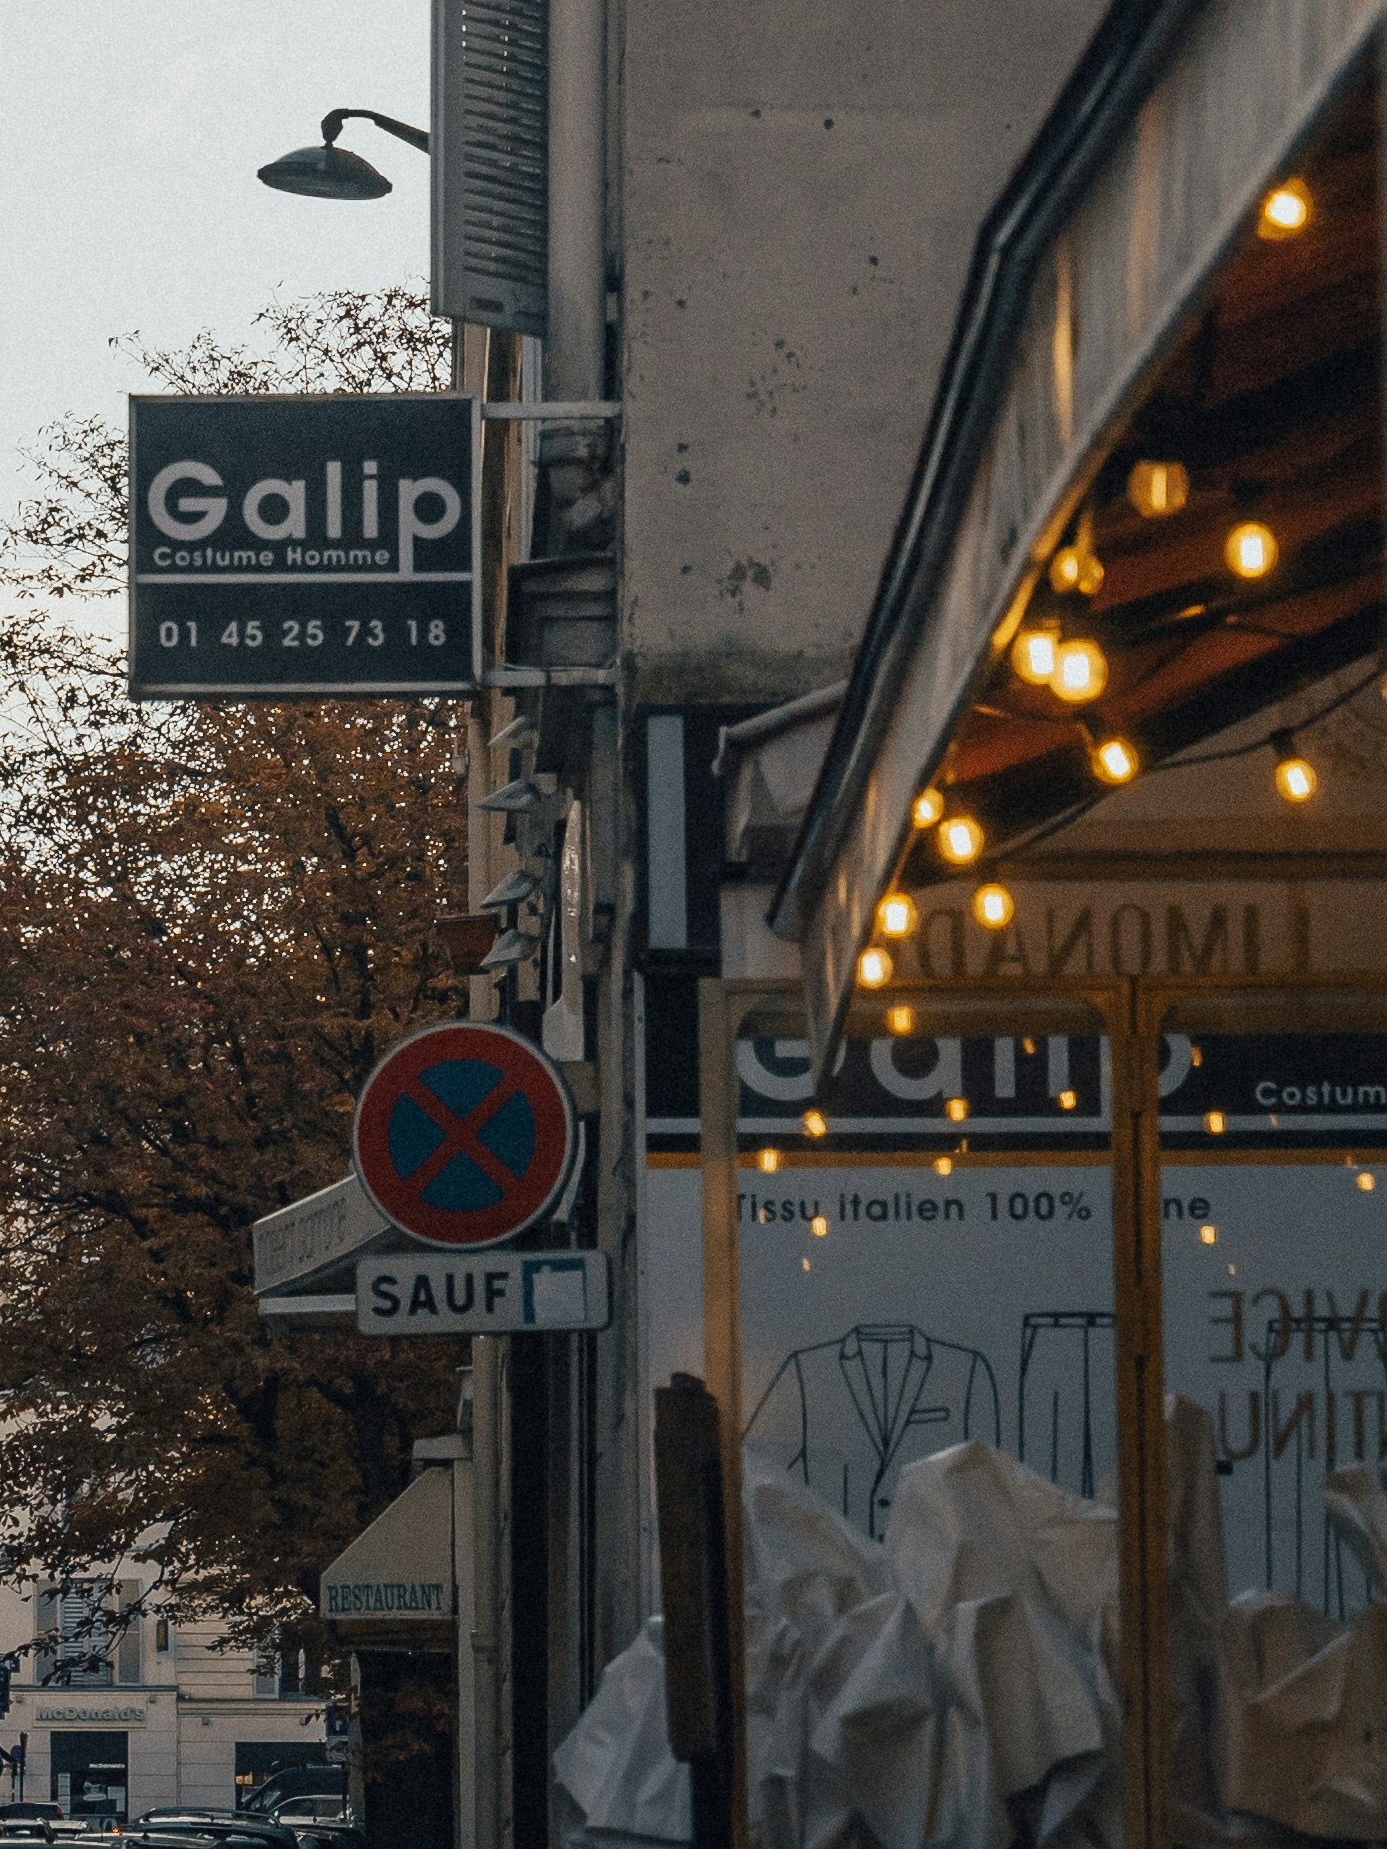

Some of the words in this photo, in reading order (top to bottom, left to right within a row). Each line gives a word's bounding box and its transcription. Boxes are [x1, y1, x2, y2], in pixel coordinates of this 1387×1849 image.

[147, 459, 463, 578] Galip
[153, 546, 273, 568] Costume
[287, 546, 391, 567] Homme
[159, 620, 198, 648] 01
[220, 620, 263, 647] 45
[282, 620, 324, 647] 25
[344, 619, 385, 647] 73
[407, 619, 446, 647] 18
[838, 1192, 965, 1222] italien
[984, 1192, 1093, 1222] 100%
[370, 1272, 511, 1318] SAUF
[326, 1582, 445, 1614] RESTAURANT
[35, 1706, 146, 1723] McDonald's
